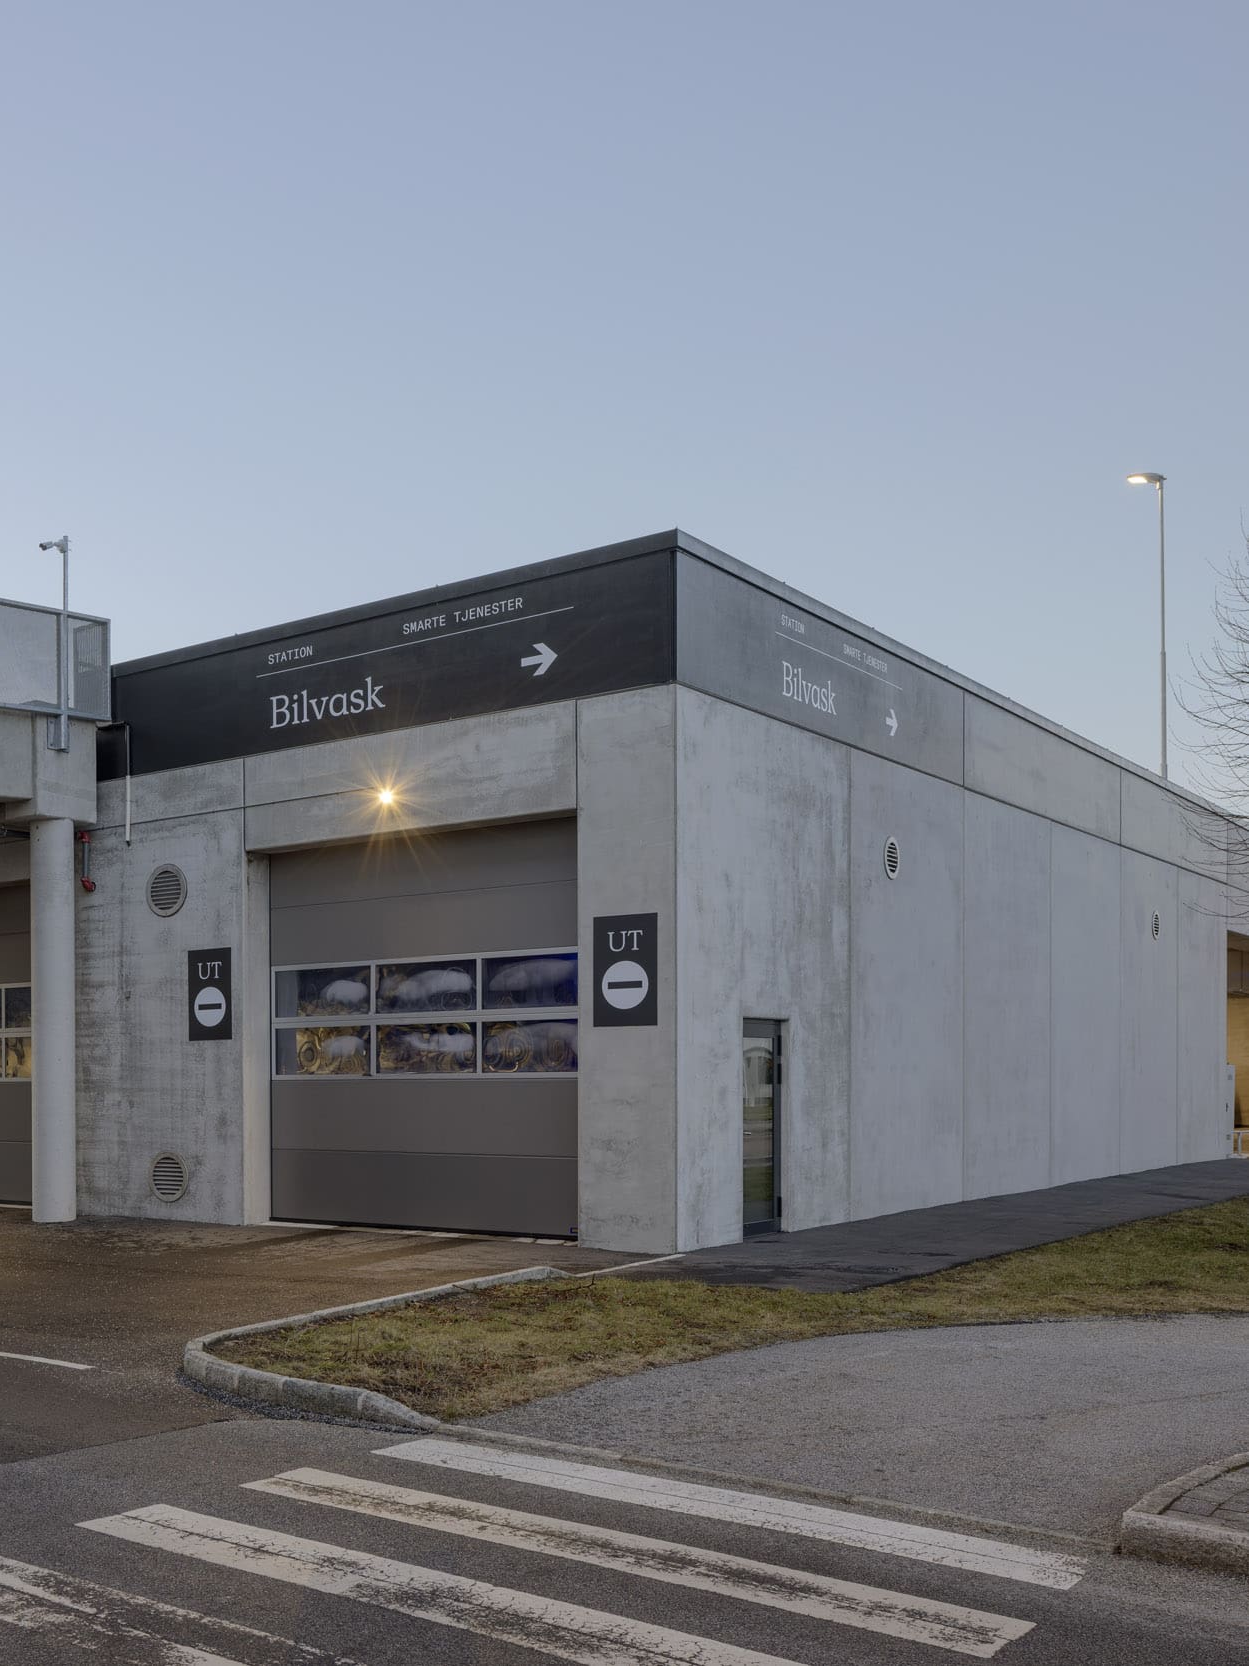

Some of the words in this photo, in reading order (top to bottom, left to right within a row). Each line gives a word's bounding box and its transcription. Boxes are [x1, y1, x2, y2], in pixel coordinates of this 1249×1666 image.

[402, 615, 446, 635] SMARTE
[453, 597, 523, 623] TJENESTER
[781, 614, 805, 633] STATION
[268, 646, 313, 665] STATION
[782, 661, 837, 715] Bilvask
[270, 676, 386, 729] Bilvask
[607, 930, 643, 952] UT
[197, 961, 223, 980] UT
